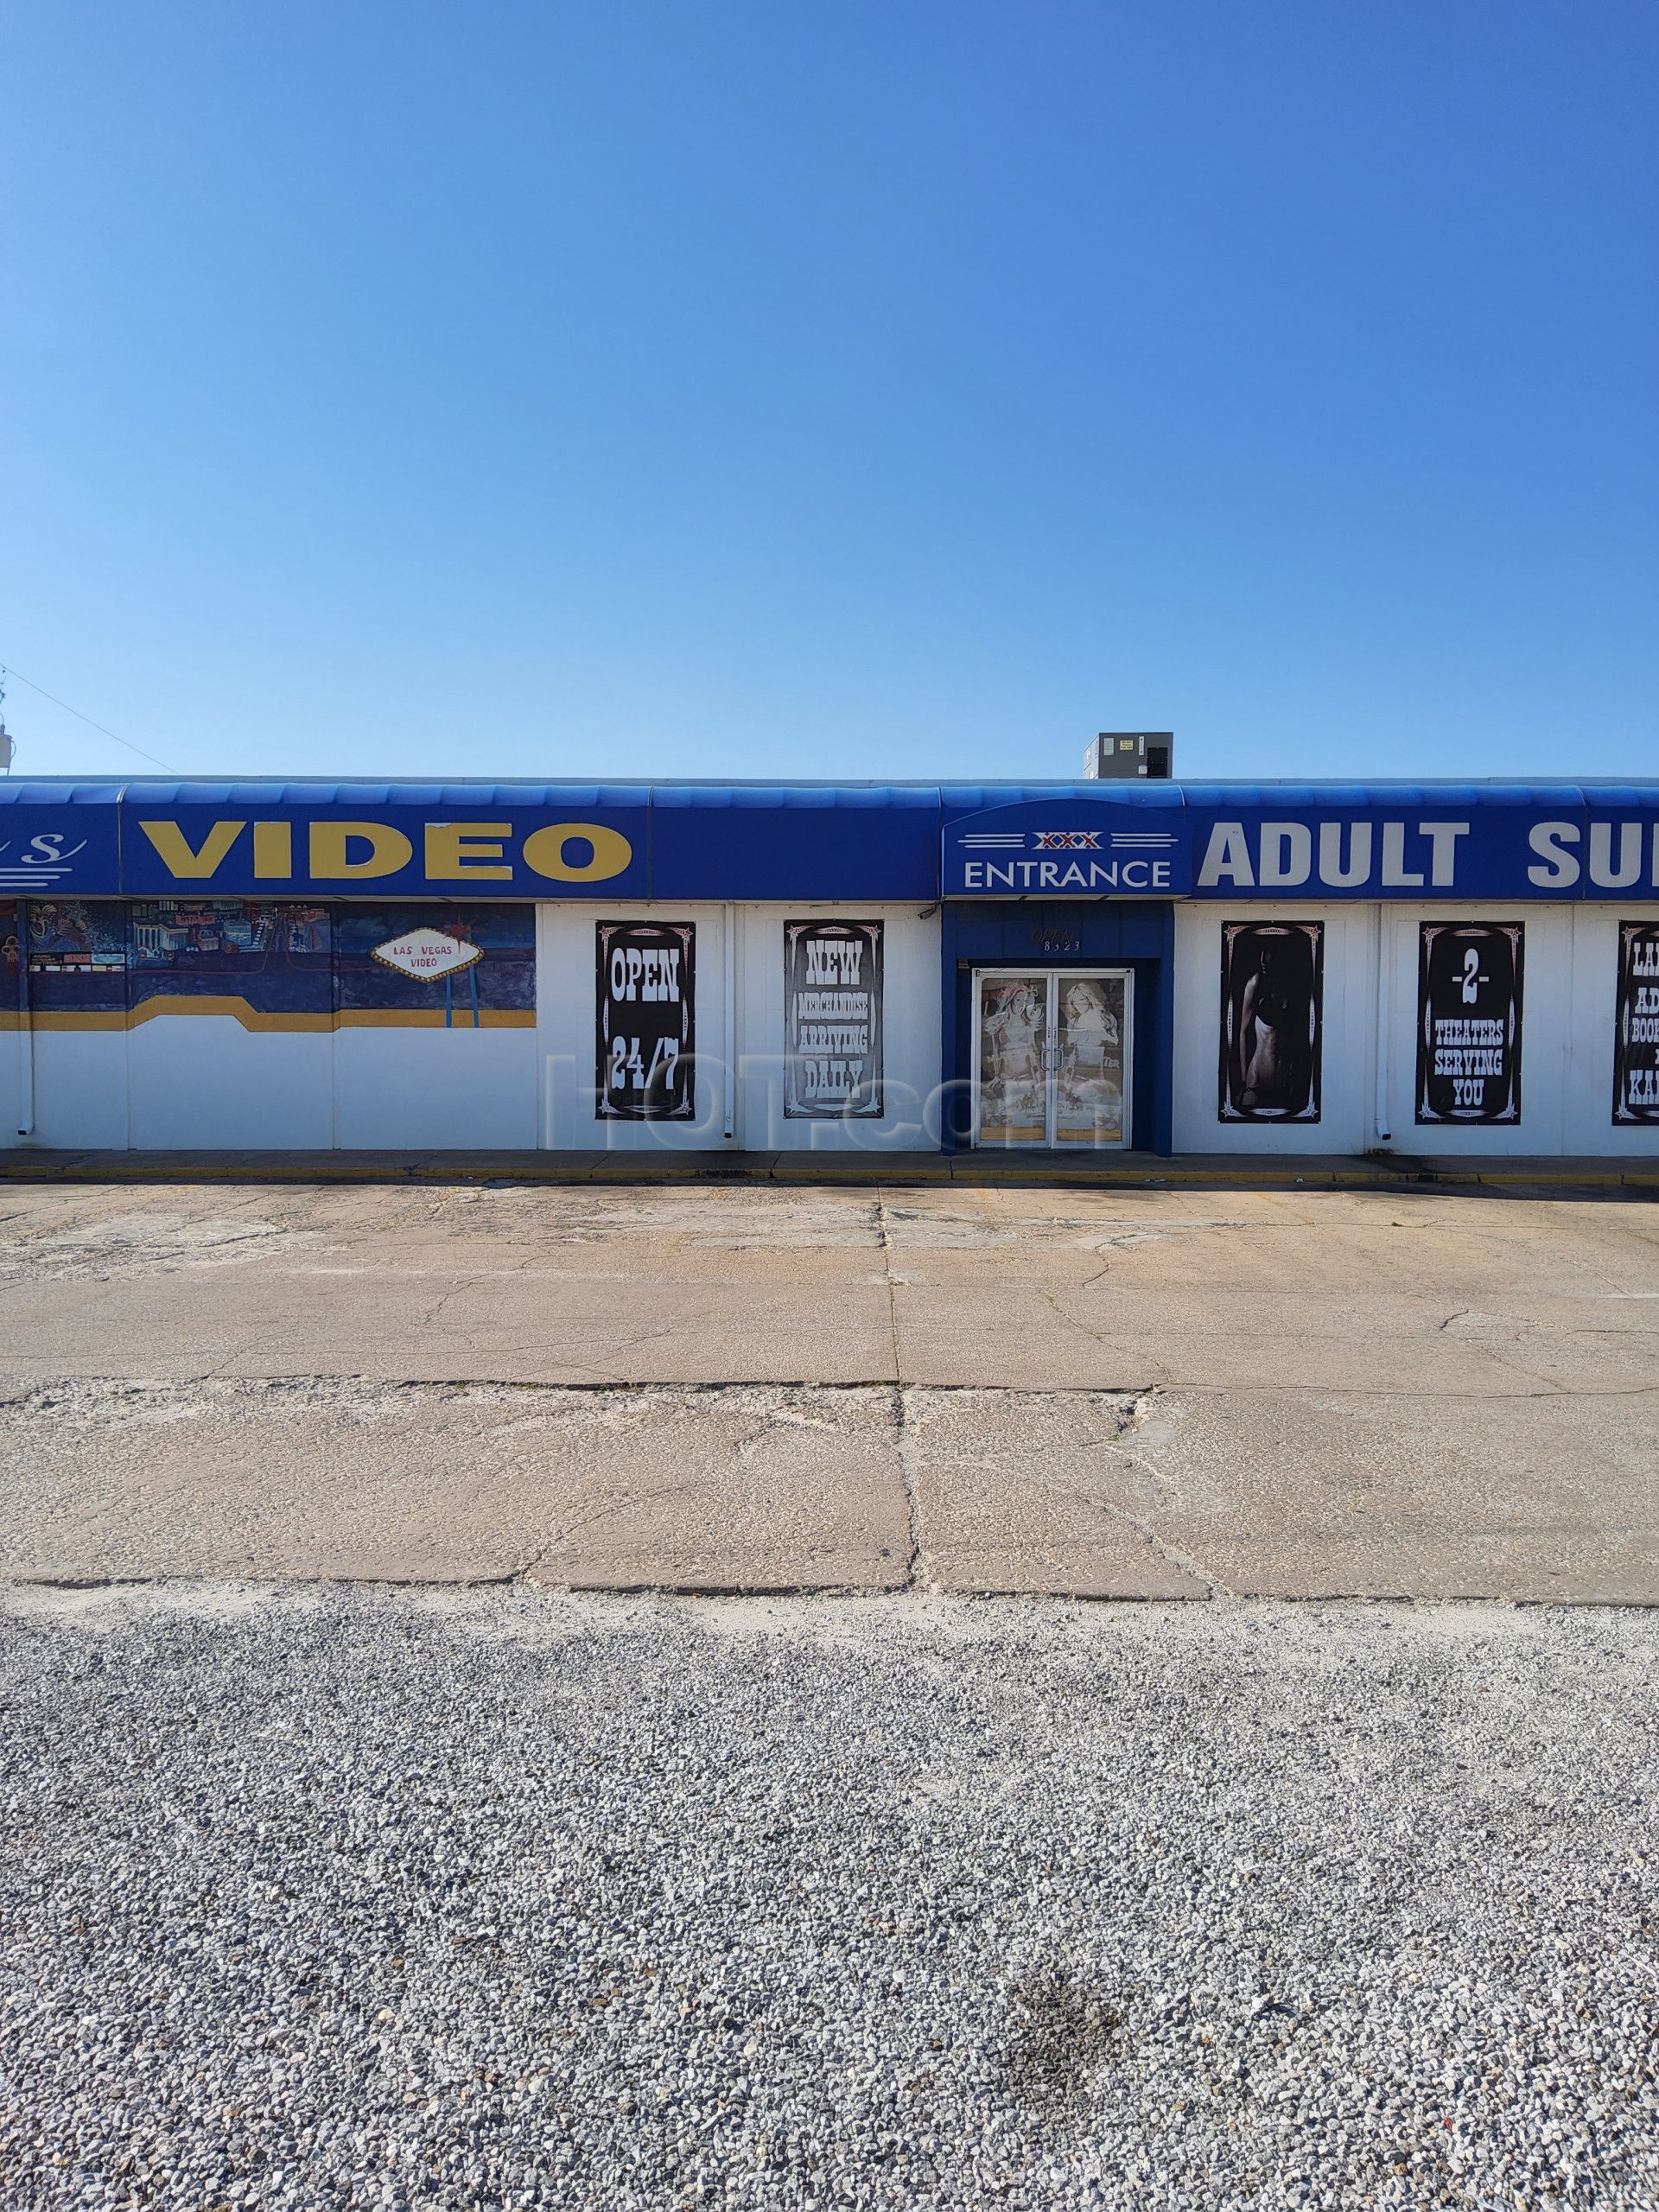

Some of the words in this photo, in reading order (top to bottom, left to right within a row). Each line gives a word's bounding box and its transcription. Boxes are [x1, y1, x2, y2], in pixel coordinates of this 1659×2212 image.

[138, 821, 632, 882] VIDEO
[1032, 831, 1104, 849] XXX
[1197, 822, 1470, 887] ADULT
[1528, 822, 1659, 887] SU
[964, 861, 1171, 887] ENTRANCE
[393, 946, 413, 955] LAS
[421, 946, 452, 955] VEGAS
[410, 958, 437, 967] VIDEO
[805, 939, 863, 985] NEW
[1633, 943, 1659, 976] LA
[611, 948, 679, 1002] OPEN
[798, 992, 868, 1020] MERCHANDISE
[798, 1025, 868, 1053] ARRIVING
[1434, 1019, 1504, 1046] THEATERS
[611, 1036, 679, 1090] 24/7
[1434, 1048, 1503, 1076] SERVING
[804, 1059, 863, 1098] DAILY
[1452, 1078, 1484, 1106] YOU
[1628, 1070, 1659, 1105] KA
